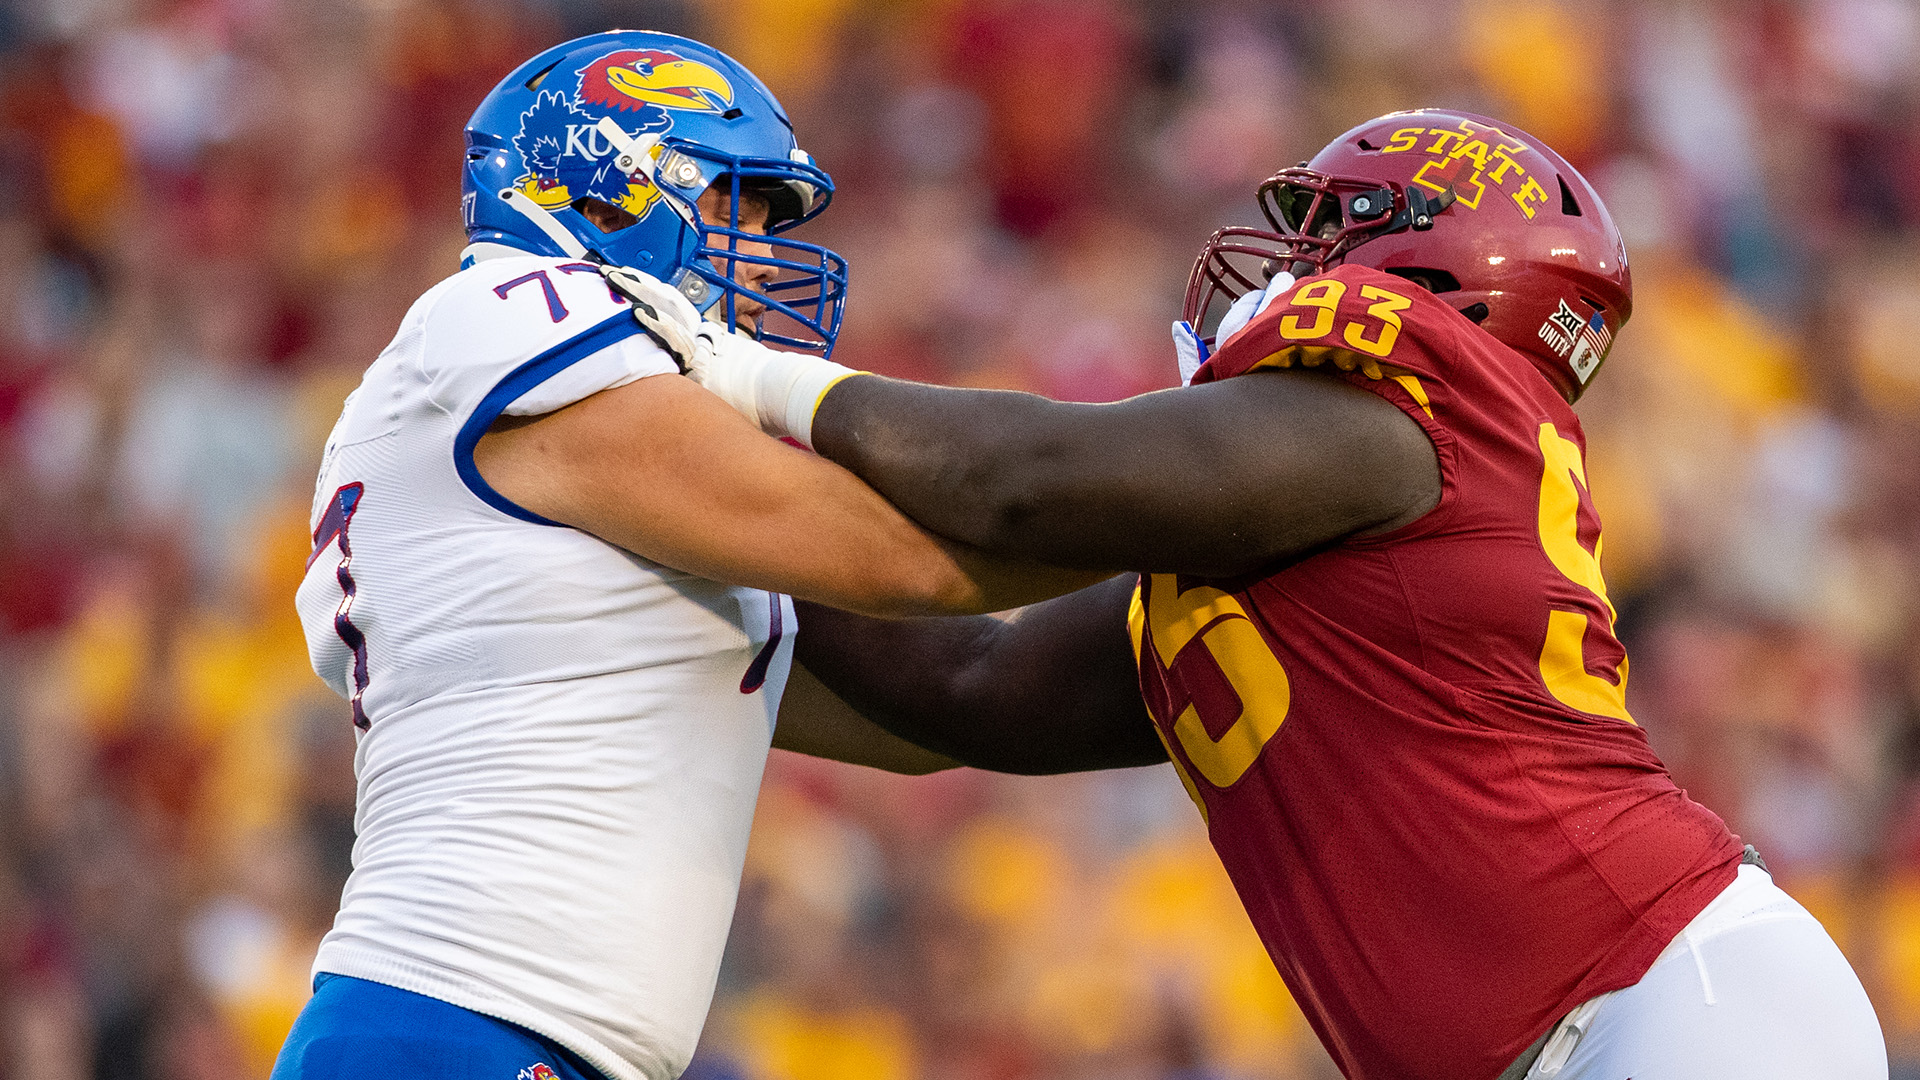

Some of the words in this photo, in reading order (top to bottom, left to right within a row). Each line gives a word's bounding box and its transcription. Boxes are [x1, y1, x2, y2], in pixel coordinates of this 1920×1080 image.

[562, 124, 614, 162] KU
[1381, 127, 1549, 220] STATE
[1279, 278, 1412, 358] 93
[1537, 321, 1571, 358] UNITY
